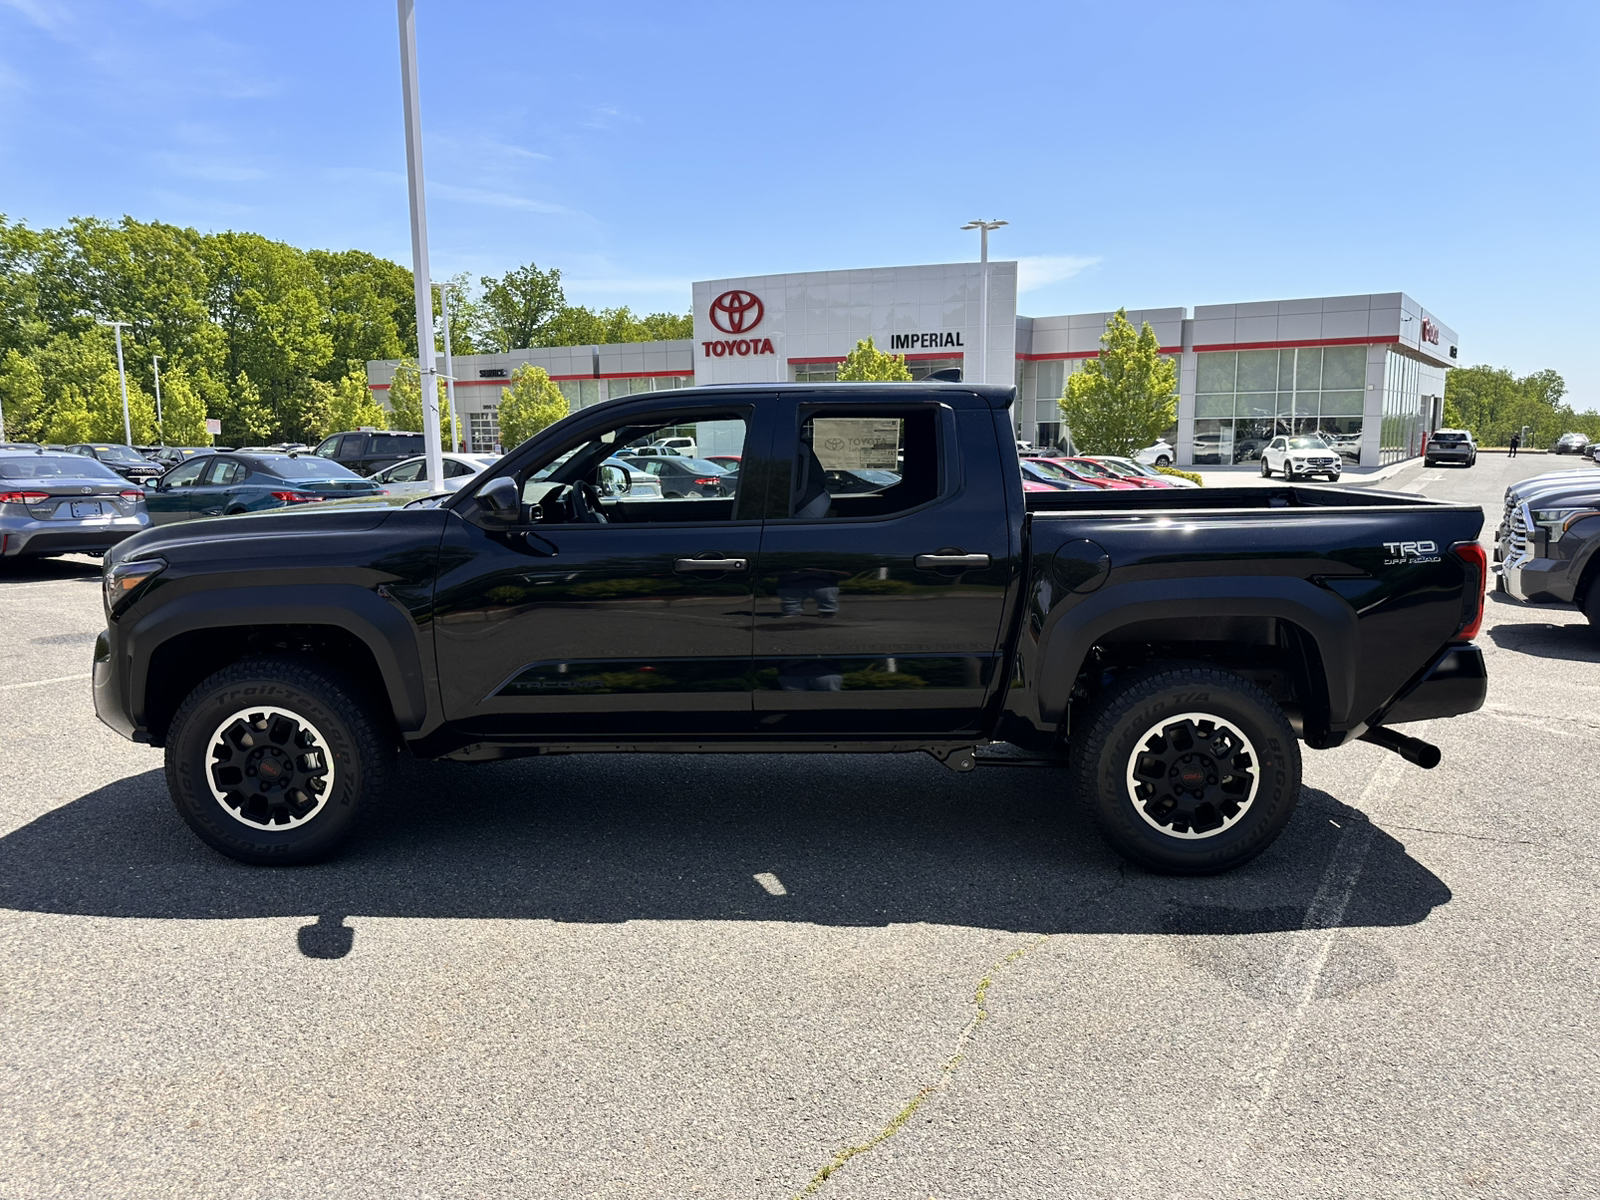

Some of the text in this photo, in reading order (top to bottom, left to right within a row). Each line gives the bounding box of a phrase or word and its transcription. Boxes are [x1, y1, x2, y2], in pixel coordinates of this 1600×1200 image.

[701, 338, 775, 357] TOYOTA
[890, 332, 964, 350] IMPERIAL
[479, 369, 506, 378] SERVICE
[847, 437, 887, 446] TOYOTA
[1382, 540, 1439, 557] TRD
[1383, 556, 1442, 565] OFF ROAD
[511, 680, 605, 689] TACOMA
[1172, 691, 1211, 703] T/A
[215, 685, 351, 762] Trail-Terrain
[1210, 737, 1285, 860] BFGoodrich
[178, 761, 290, 855] BFGoodrich
